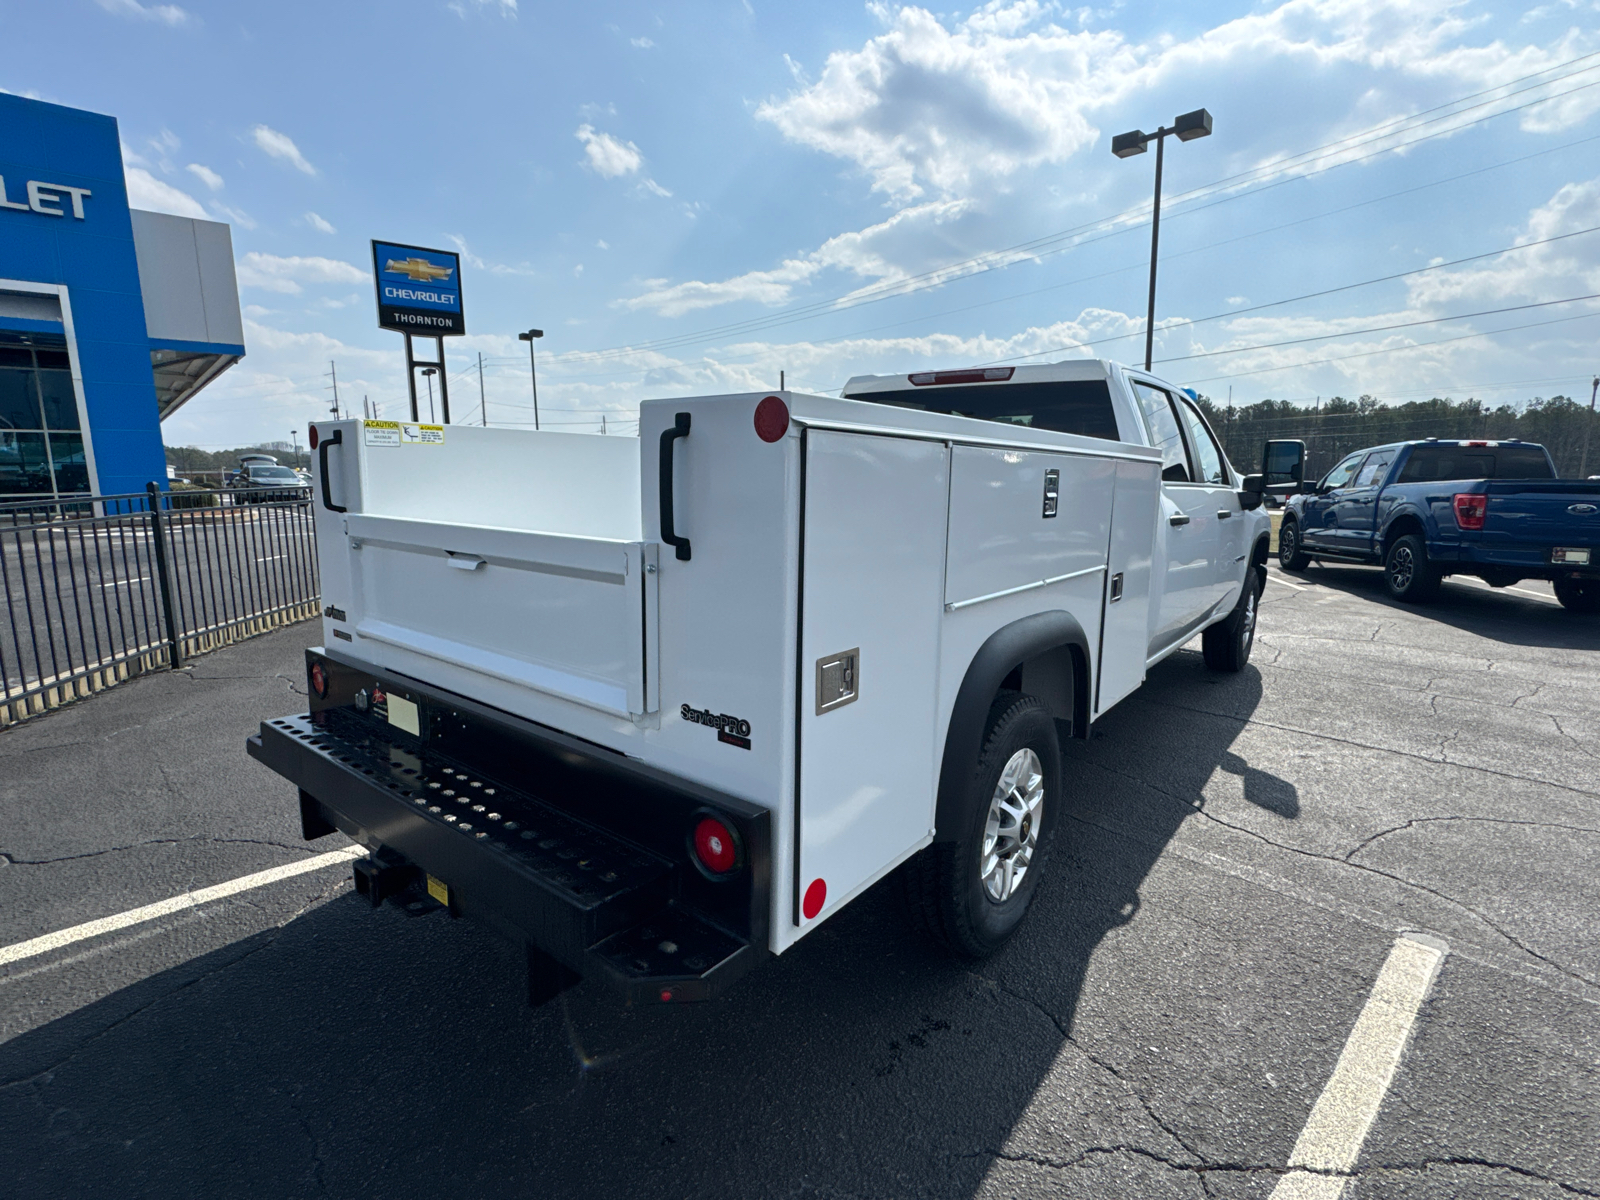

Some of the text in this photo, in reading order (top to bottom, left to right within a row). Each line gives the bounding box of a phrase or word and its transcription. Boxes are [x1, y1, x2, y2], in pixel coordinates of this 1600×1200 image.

[385, 287, 455, 304] CHEVROLET
[393, 313, 453, 327] THORNTON
[681, 703, 751, 737] ServicePRO
